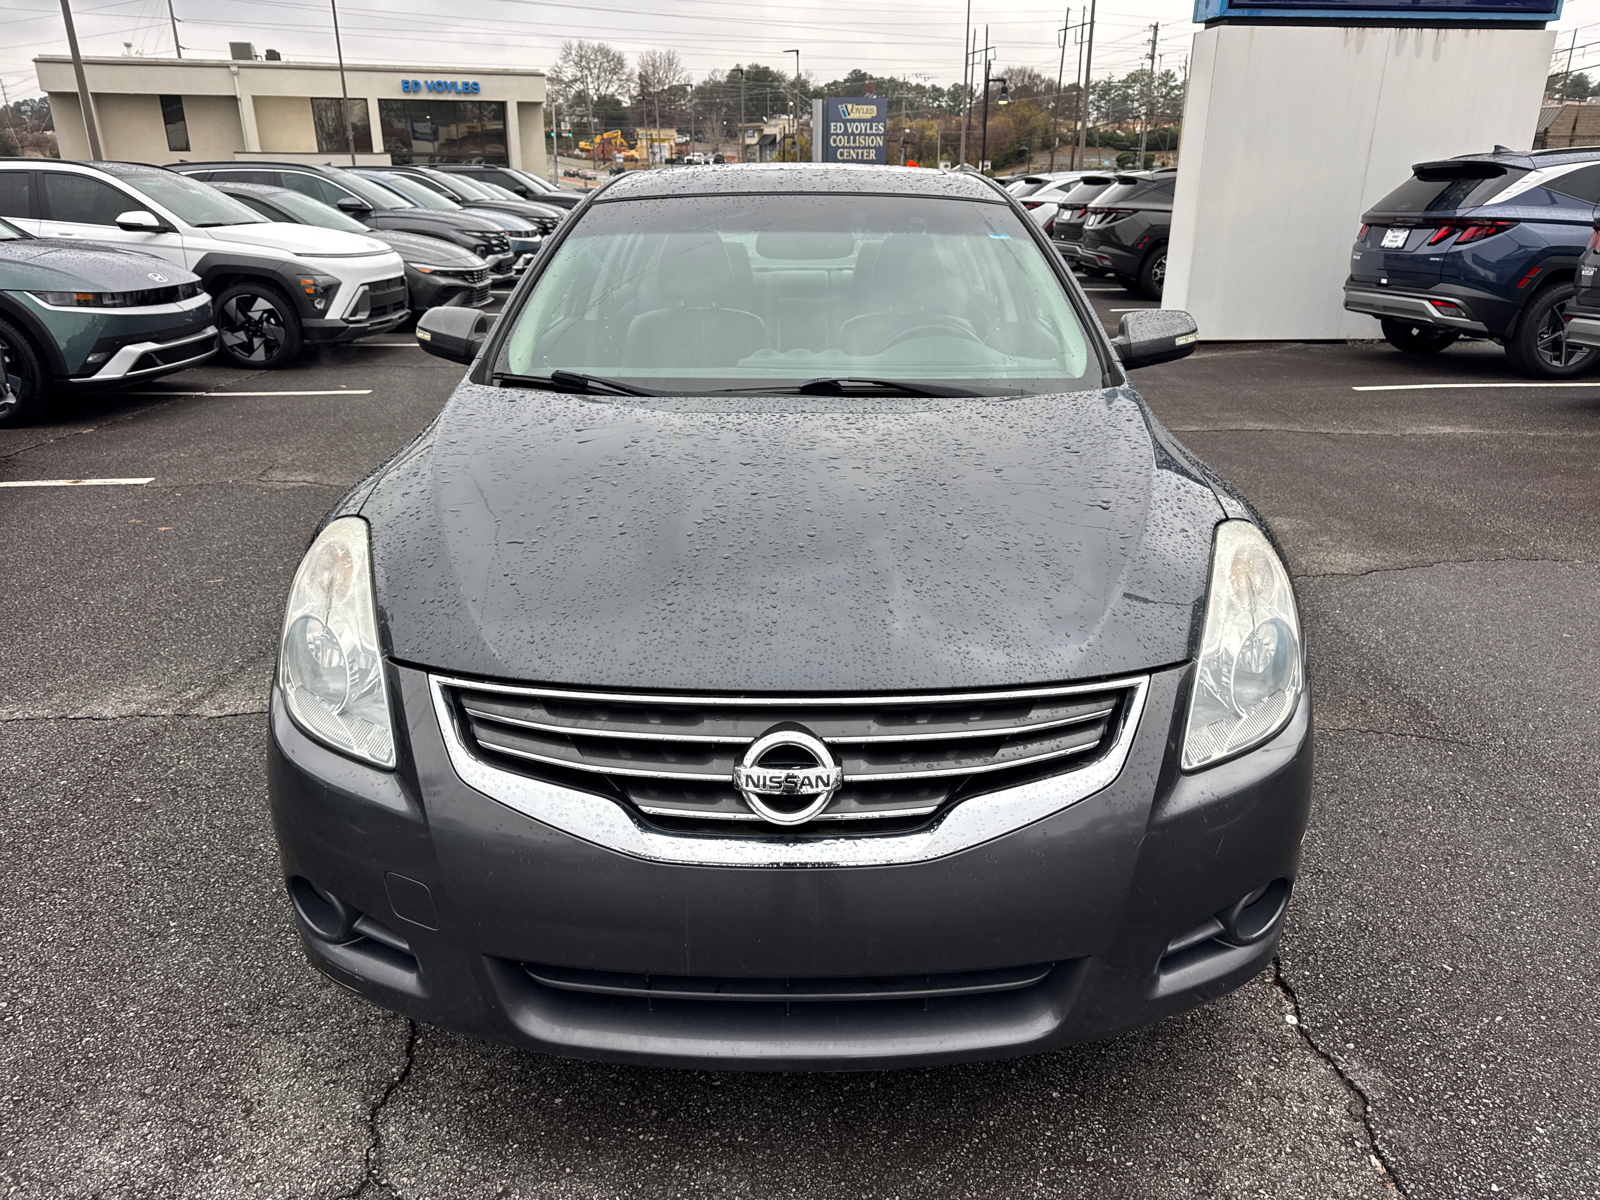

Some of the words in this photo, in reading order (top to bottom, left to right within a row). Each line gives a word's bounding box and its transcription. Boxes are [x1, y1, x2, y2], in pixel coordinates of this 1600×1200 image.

[401, 79, 422, 92] ED
[424, 80, 480, 93] VOYLES
[830, 122, 844, 133] ED
[846, 122, 885, 134] VOYLES
[830, 135, 884, 147] COLLISION
[836, 148, 876, 160] CENTER
[745, 773, 831, 790] NISSAN
